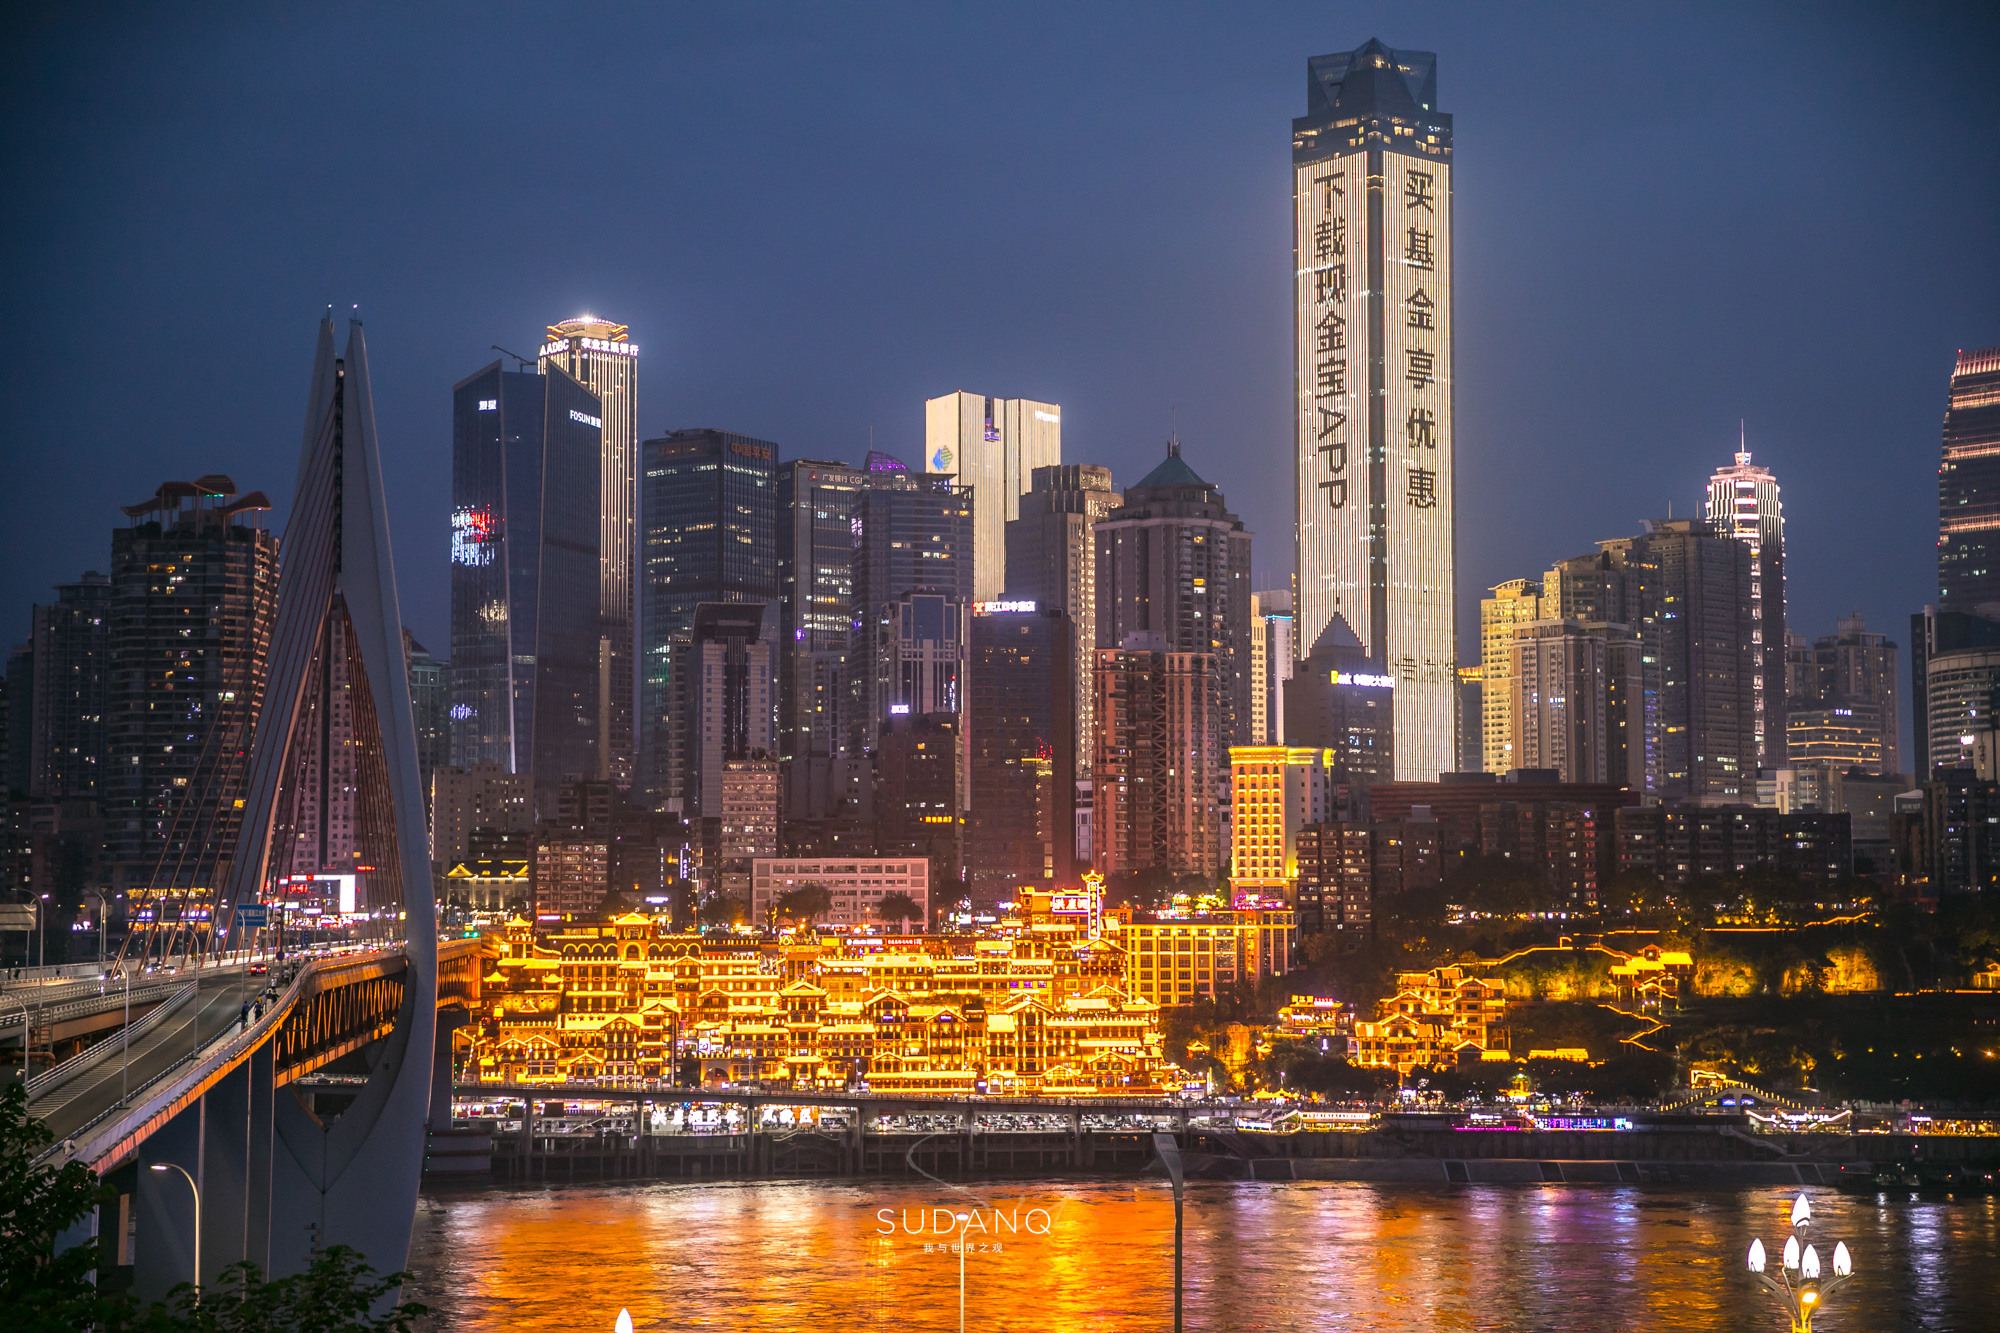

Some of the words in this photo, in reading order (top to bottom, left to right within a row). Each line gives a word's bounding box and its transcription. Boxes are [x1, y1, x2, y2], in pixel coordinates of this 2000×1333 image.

[1404, 170, 1436, 509] 买基金享优惠
[731, 442, 771, 461] 中国平安
[822, 473, 848, 484] 广发银行
[1054, 897, 1088, 910] 洪崖洞
